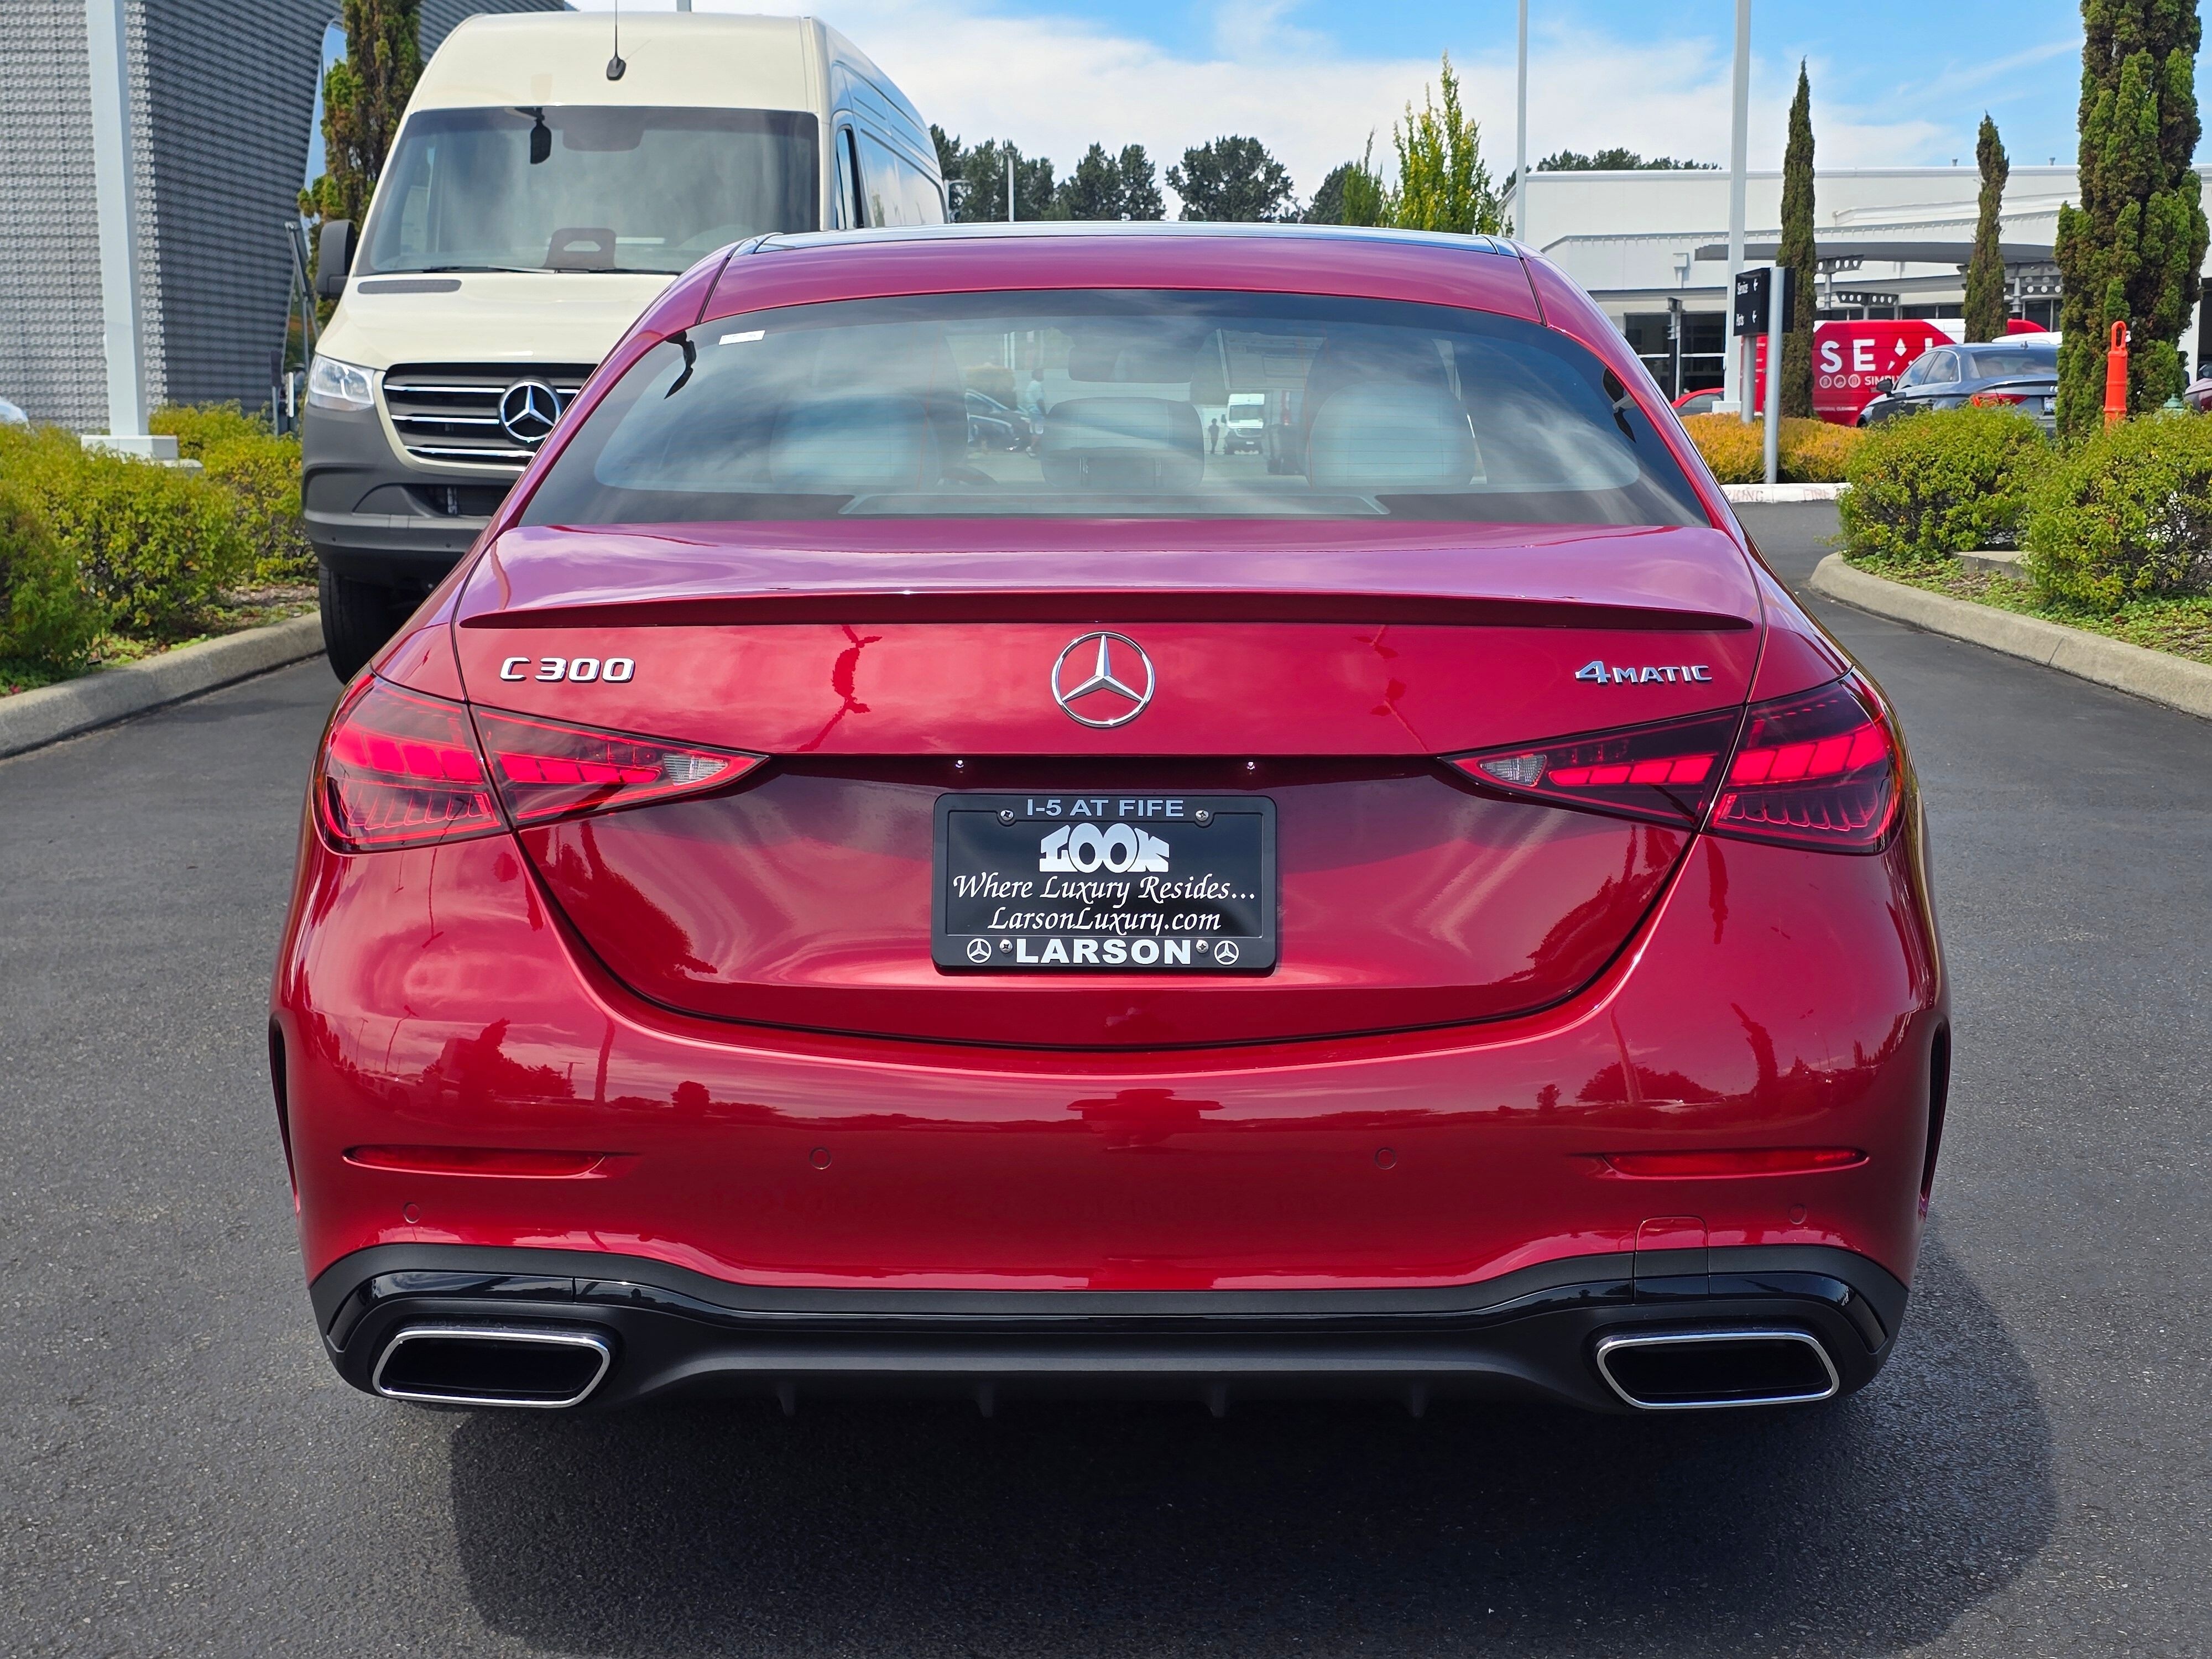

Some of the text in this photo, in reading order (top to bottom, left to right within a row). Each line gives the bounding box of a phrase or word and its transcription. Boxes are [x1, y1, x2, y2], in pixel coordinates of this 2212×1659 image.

[499, 657, 636, 683] C 300
[1575, 660, 1713, 684] 4MATIC
[1027, 799, 1184, 817] I-5 AT FIFE
[1039, 822, 1170, 873] LOOK
[952, 872, 1256, 909] Where Luxury Resides...
[987, 906, 1222, 936] LarsonLuxury.com
[1016, 938, 1191, 964] LARSON
